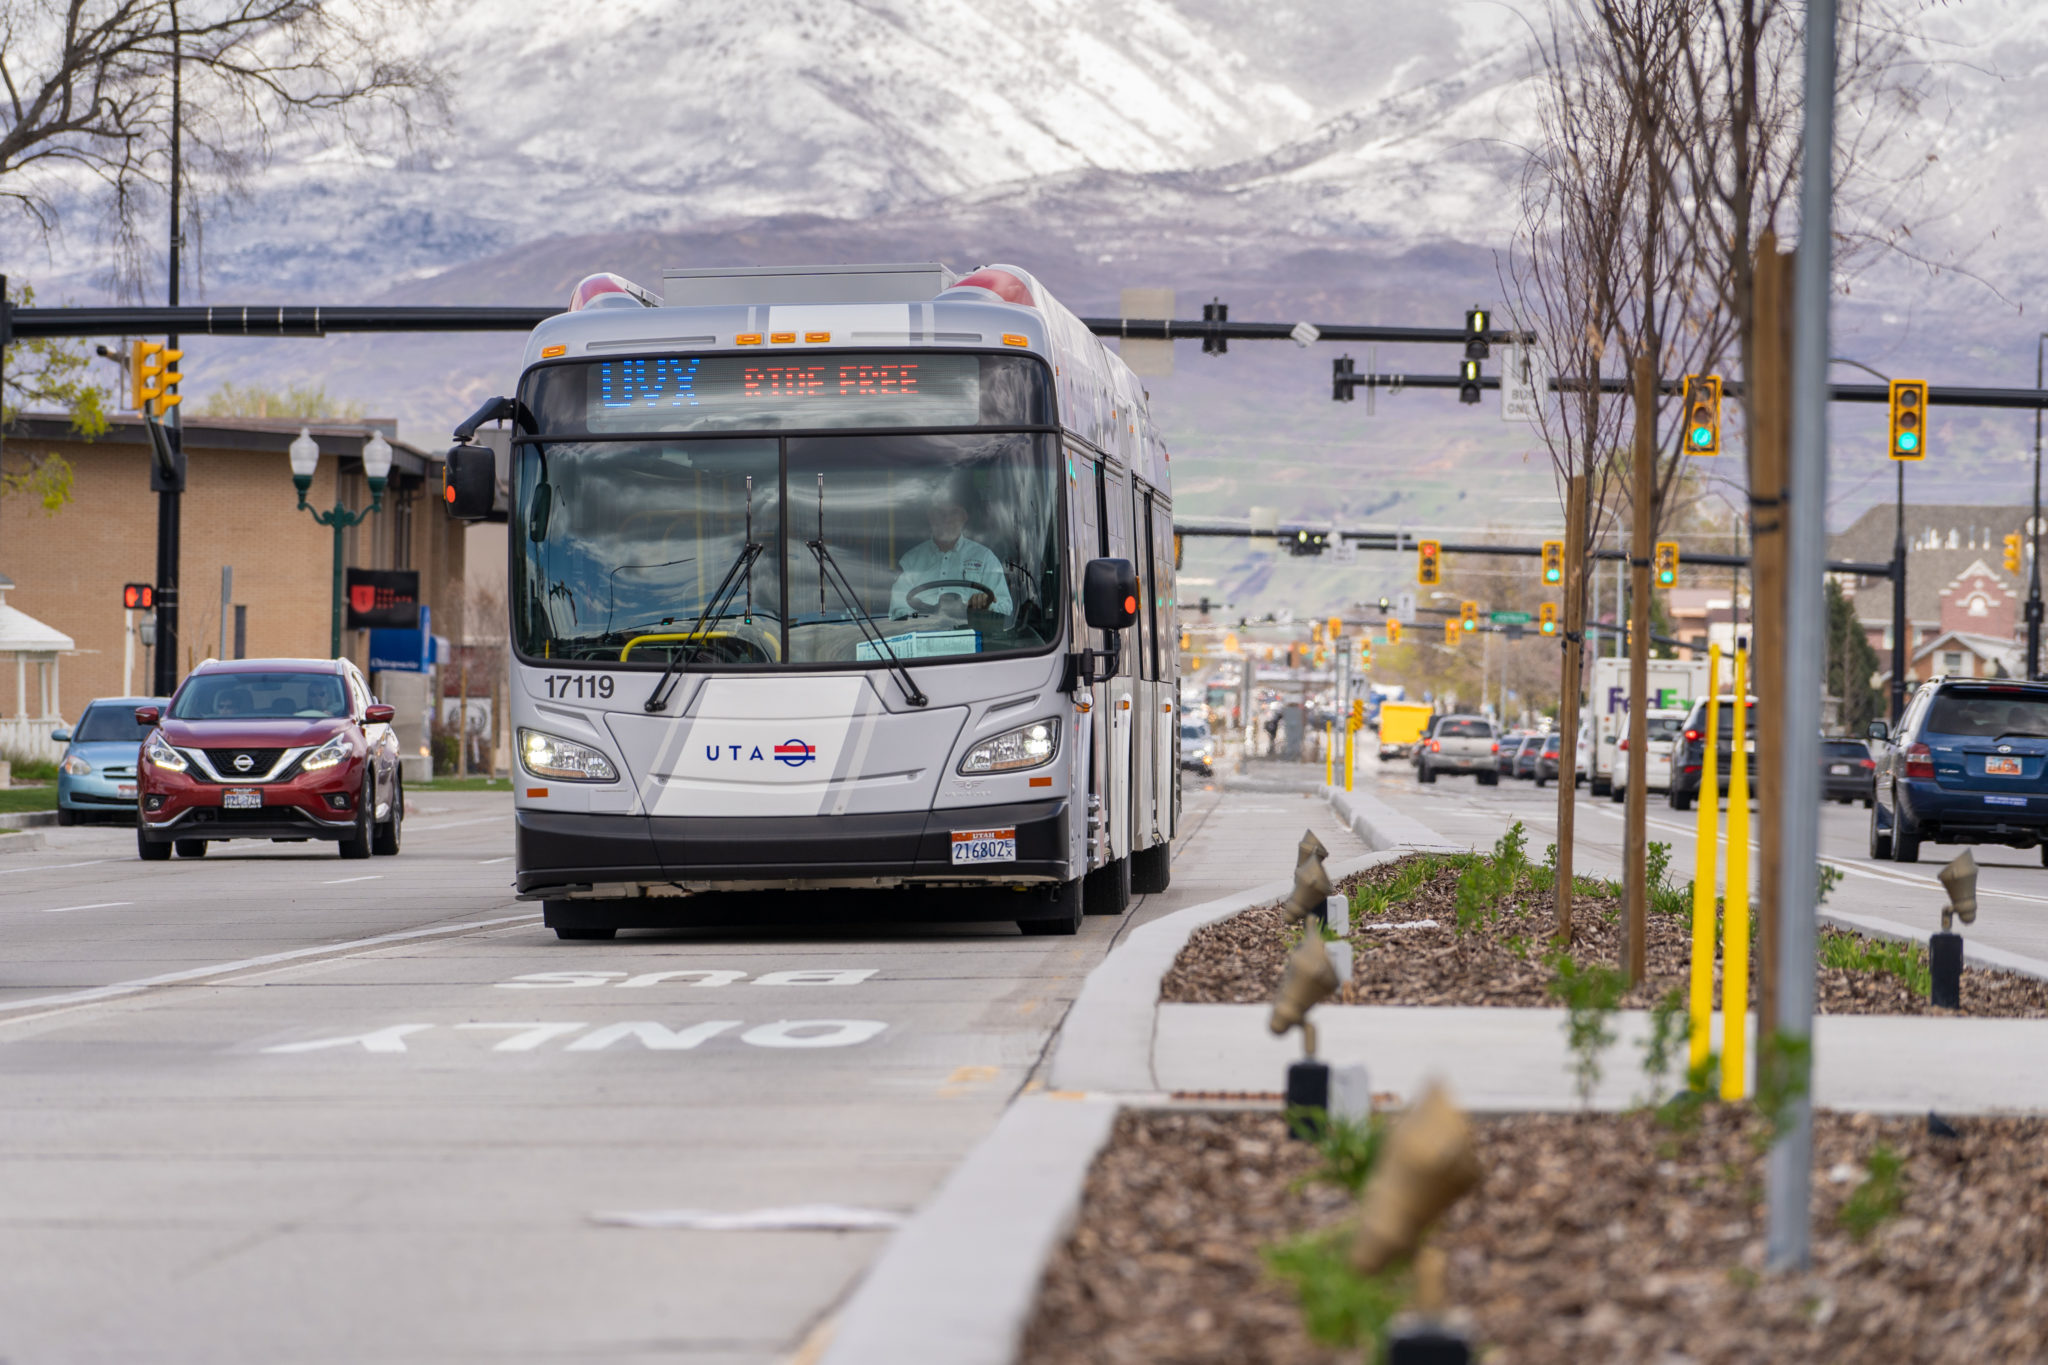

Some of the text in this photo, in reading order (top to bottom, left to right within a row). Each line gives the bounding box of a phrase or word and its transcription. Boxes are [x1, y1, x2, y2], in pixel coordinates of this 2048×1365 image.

[839, 365, 918, 395] FREE
[544, 675, 615, 699] 17119
[706, 745, 764, 761] UTA
[955, 841, 1004, 859] 216802
[495, 969, 880, 988] BUS
[260, 1019, 890, 1055] ONLY
